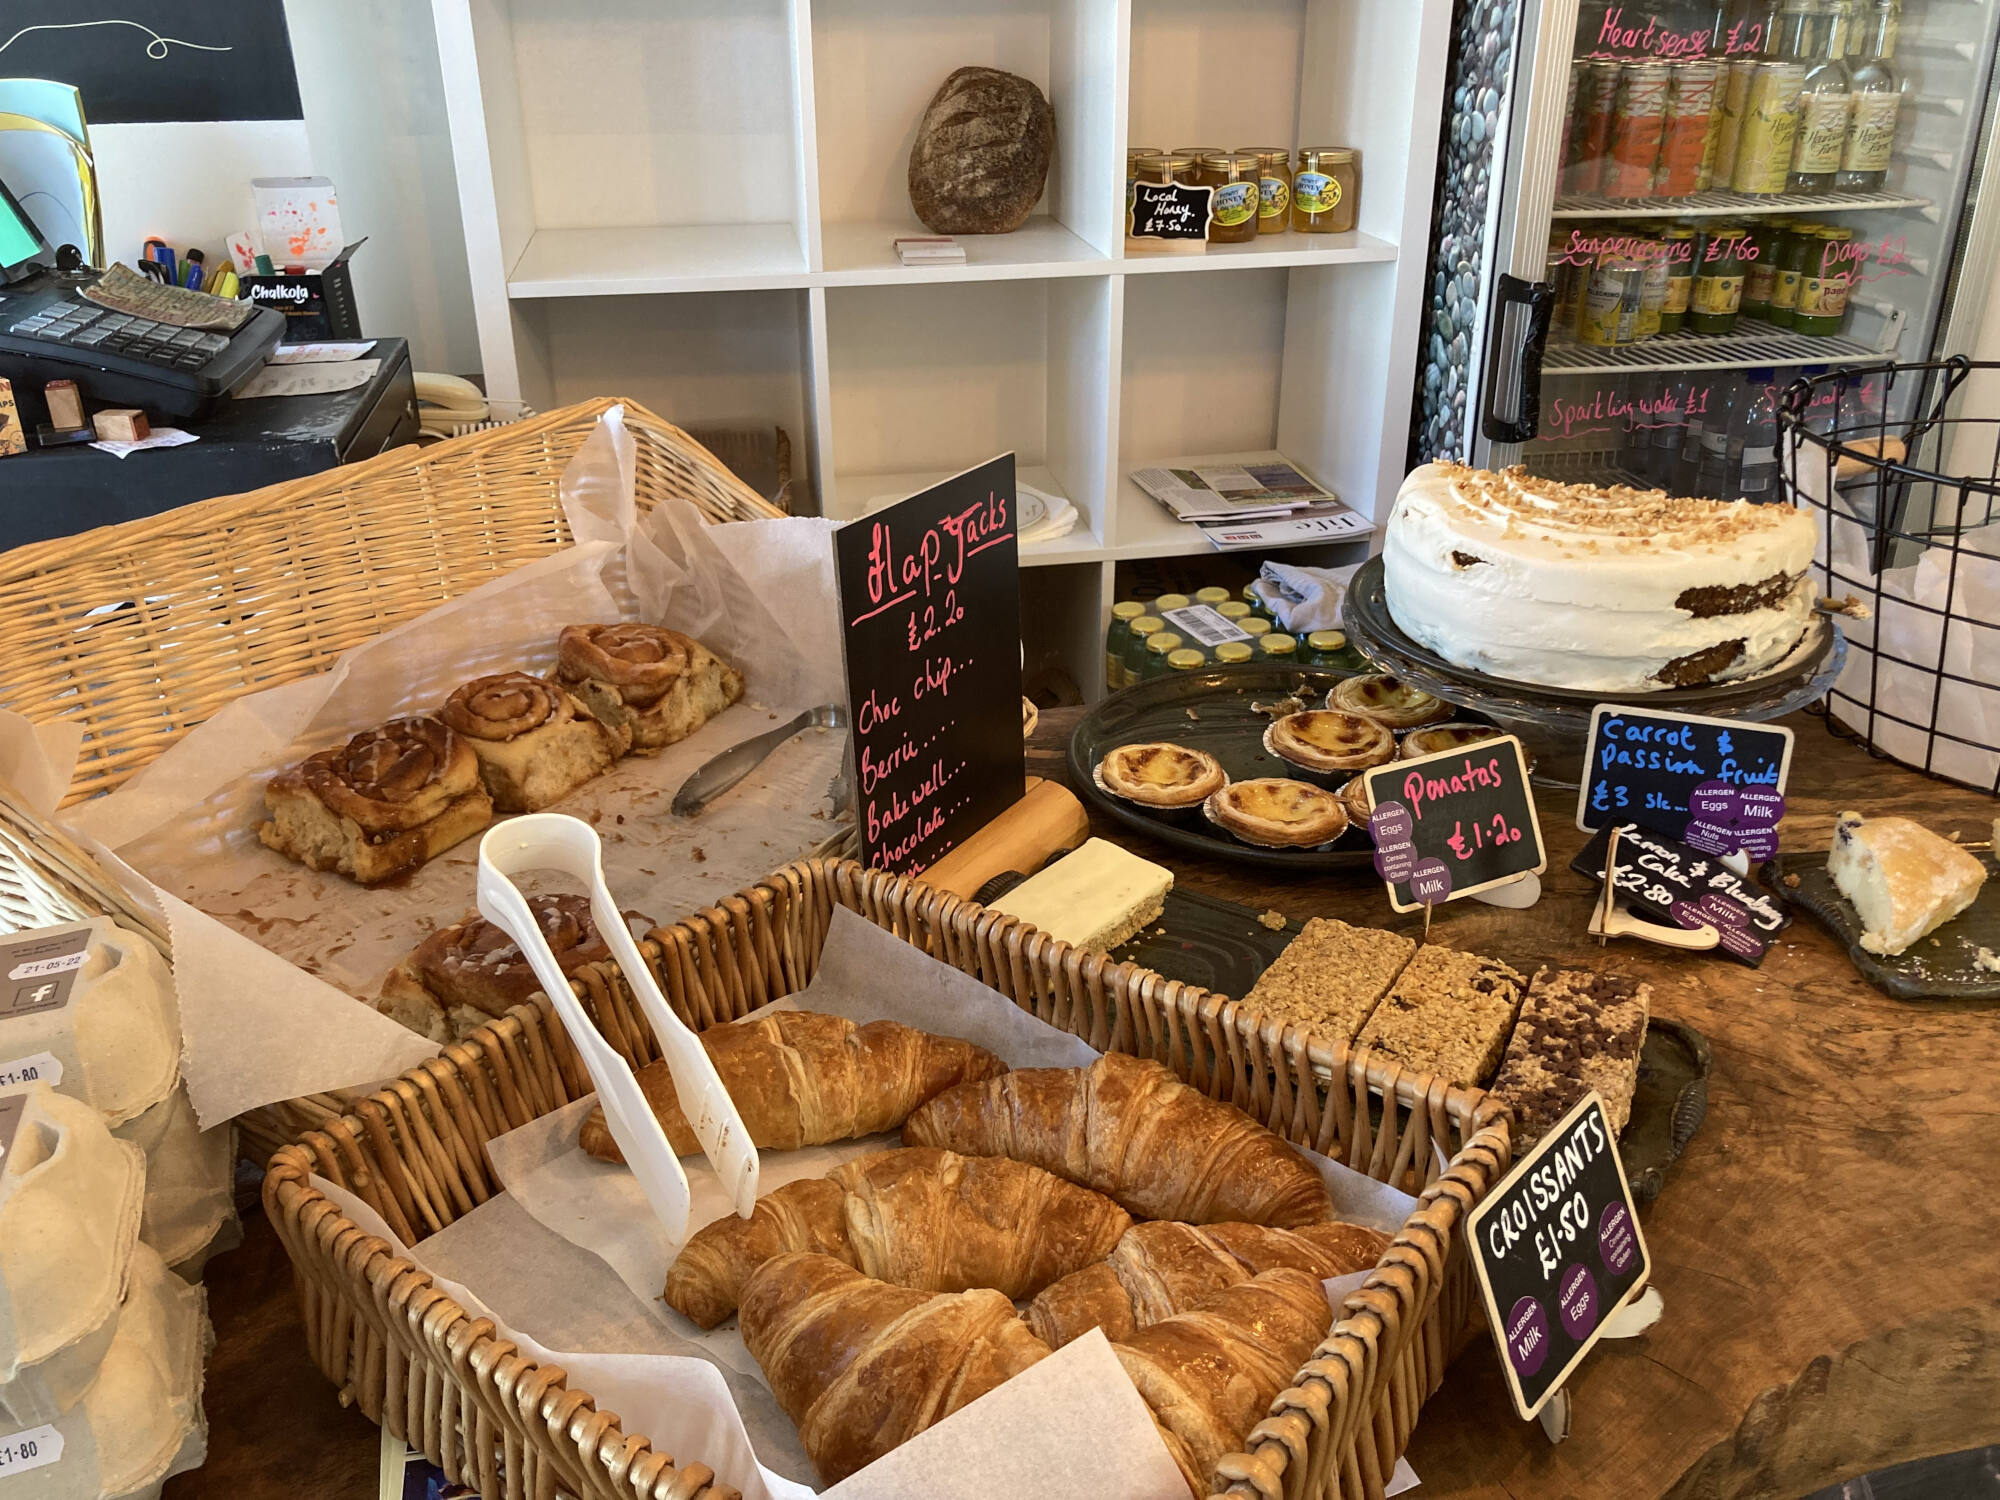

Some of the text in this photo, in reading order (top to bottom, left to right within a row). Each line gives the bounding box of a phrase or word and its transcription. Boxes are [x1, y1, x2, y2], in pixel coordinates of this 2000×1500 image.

[1725, 18, 1762, 55] £2
[1143, 188, 1178, 202] Local
[1704, 235, 1760, 262] £1.60
[251, 284, 308, 303] Chalkola
[1684, 386, 1709, 415] £1
[908, 589, 964, 651] £2.20
[859, 689, 901, 734] Choc
[1603, 719, 1697, 750] Carrot
[1592, 780, 1630, 811] £3
[1701, 800, 1729, 811] Eggs
[1740, 793, 1781, 802] ALLERGEN
[1372, 808, 1405, 822] ALLERGEN
[1744, 804, 1774, 818] Milk
[1380, 823, 1403, 836] Eggs
[1447, 813, 1522, 860] £1.20
[1693, 820, 1733, 836] ALLERGEN
[1700, 829, 1720, 841] Nuts
[1378, 841, 1411, 854] ALLERGEN
[1385, 853, 1407, 862] Cereals
[1384, 861, 1412, 871] containing
[1390, 870, 1409, 879] Gluten
[1413, 865, 1445, 878] ALLERGEN
[1638, 854, 1692, 888] Cake
[1420, 879, 1444, 895] Milk
[1680, 902, 1719, 924] ALLERGEN
[1709, 895, 1746, 917] ALLERGEN
[1709, 902, 1737, 922] Milk
[1723, 924, 1762, 947] ALLERGEN
[24, 956, 81, 974] 21-05-22
[1490, 1110, 1604, 1259] CROISSANTS
[1535, 1191, 1589, 1280] £1.50
[1601, 1206, 1625, 1243] ALLERGEN
[1561, 1268, 1586, 1309] ALLERGEN
[1570, 1291, 1590, 1321] Eggs
[1508, 1301, 1537, 1343] ALLERGEN
[1518, 1326, 1543, 1362] Milk
